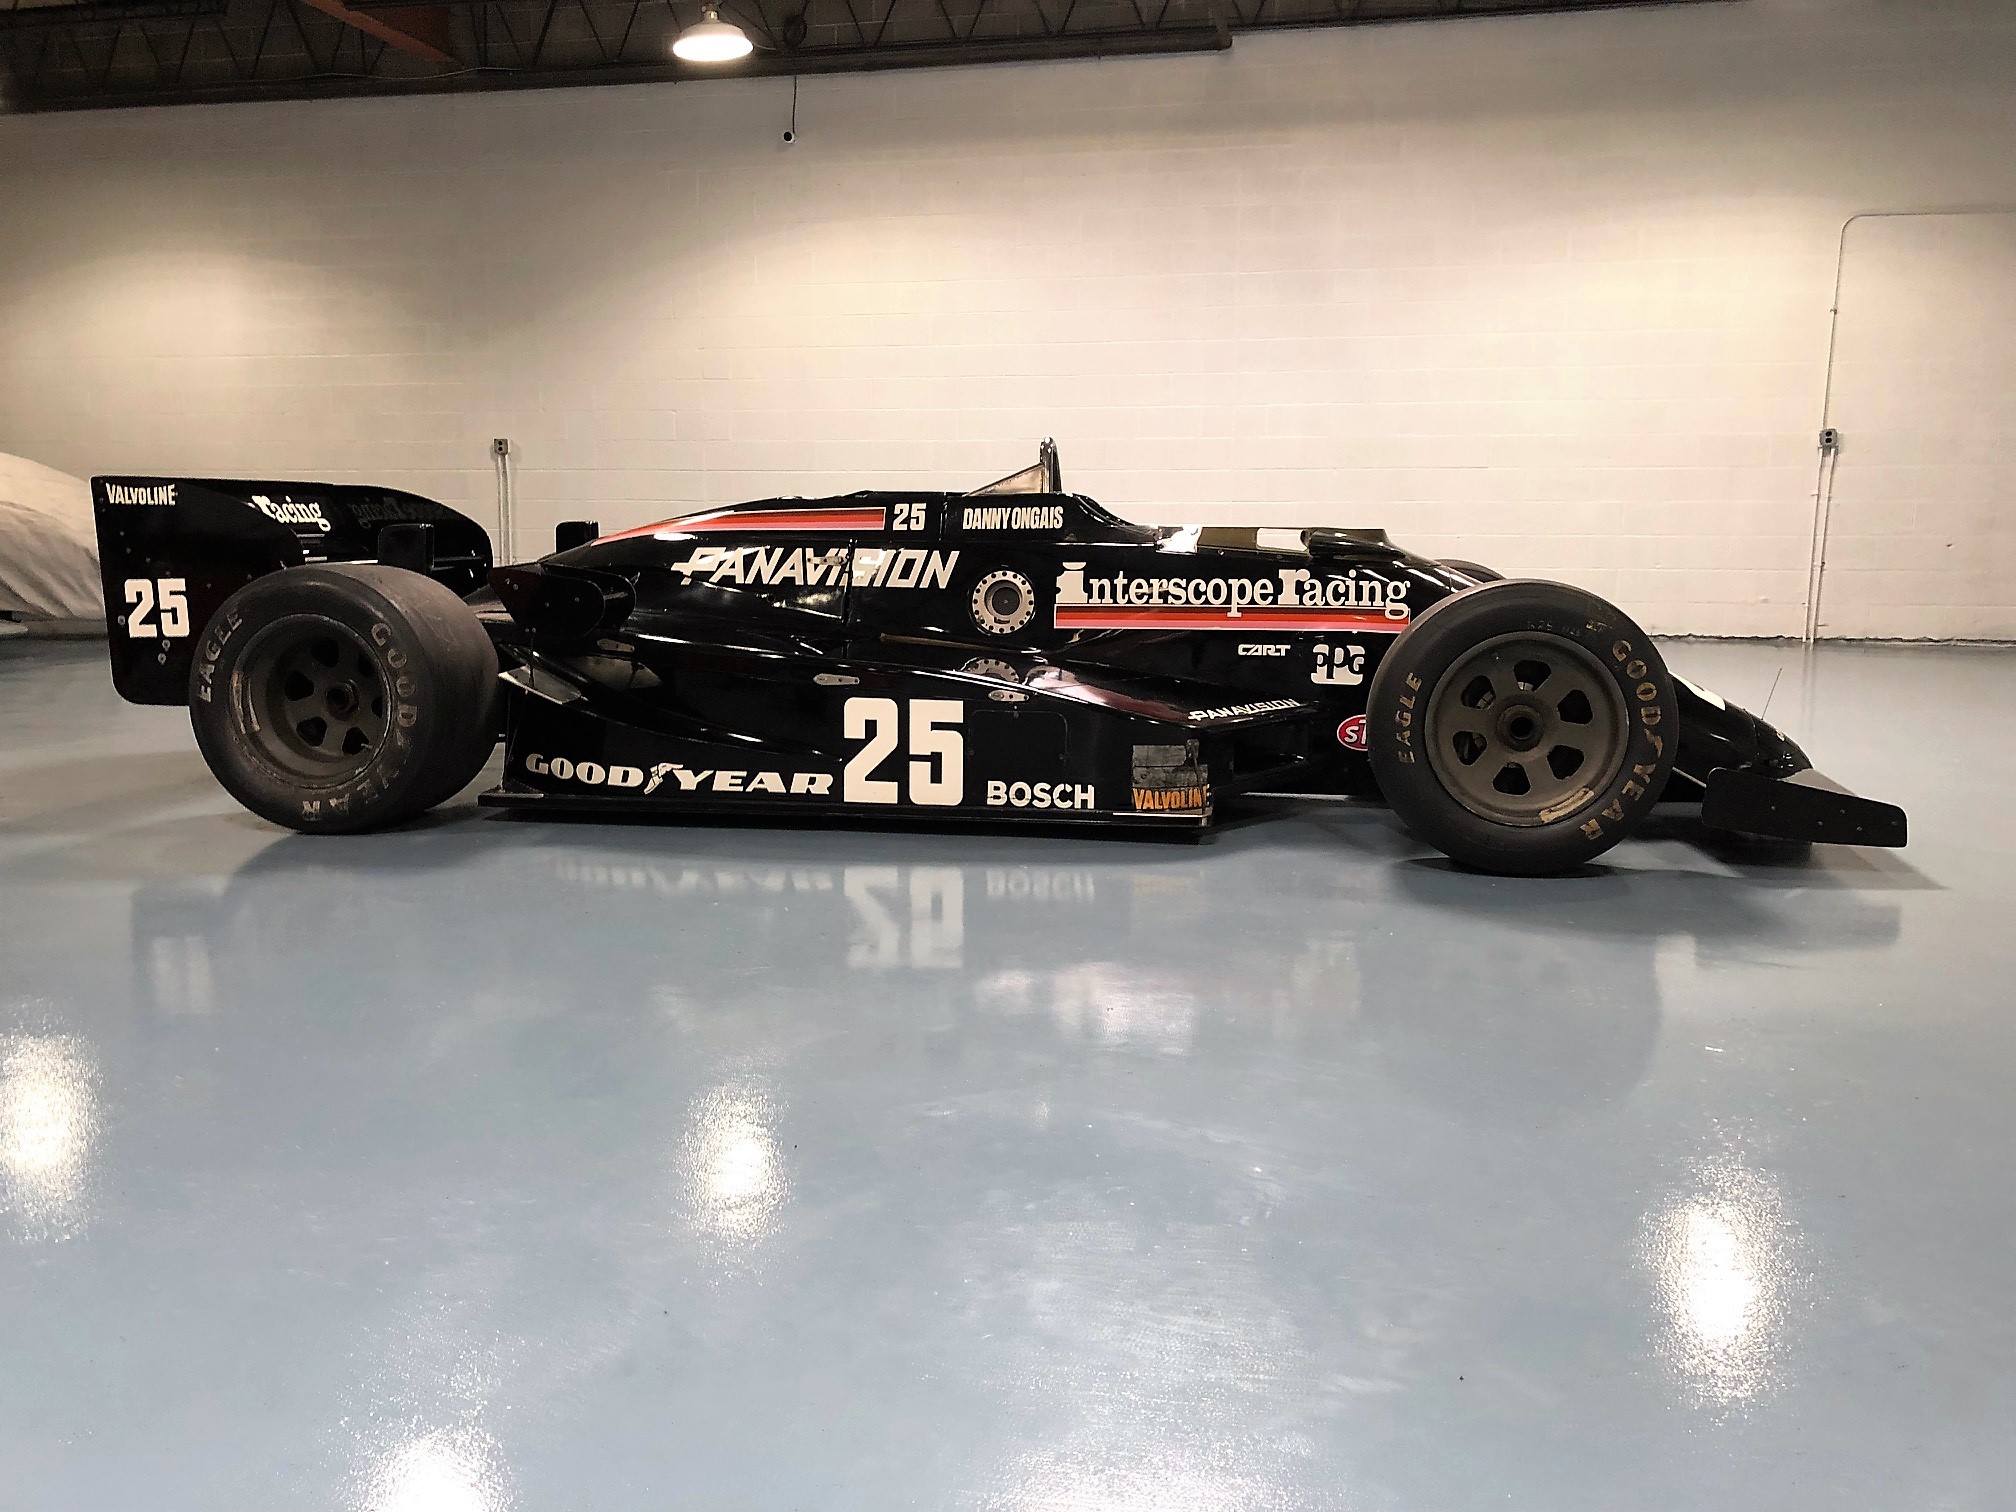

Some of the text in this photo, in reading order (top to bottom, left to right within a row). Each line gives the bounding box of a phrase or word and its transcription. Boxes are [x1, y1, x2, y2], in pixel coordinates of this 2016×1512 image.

[105, 482, 177, 506] VALVOLINE
[251, 495, 332, 532] racing
[893, 503, 927, 531] 25
[963, 506, 1064, 530] DANNY ONGAIS
[671, 546, 960, 589] PANAVISION
[124, 577, 190, 638] 25
[1277, 569, 1411, 620] racing
[198, 610, 244, 704] EAGLE
[1237, 643, 1292, 657] CART
[1187, 698, 1301, 721] PANAVISION
[1394, 672, 1423, 763] EAGLE
[1343, 718, 1368, 745] ST
[843, 697, 964, 806] 25
[986, 780, 1096, 809] BOSCH
